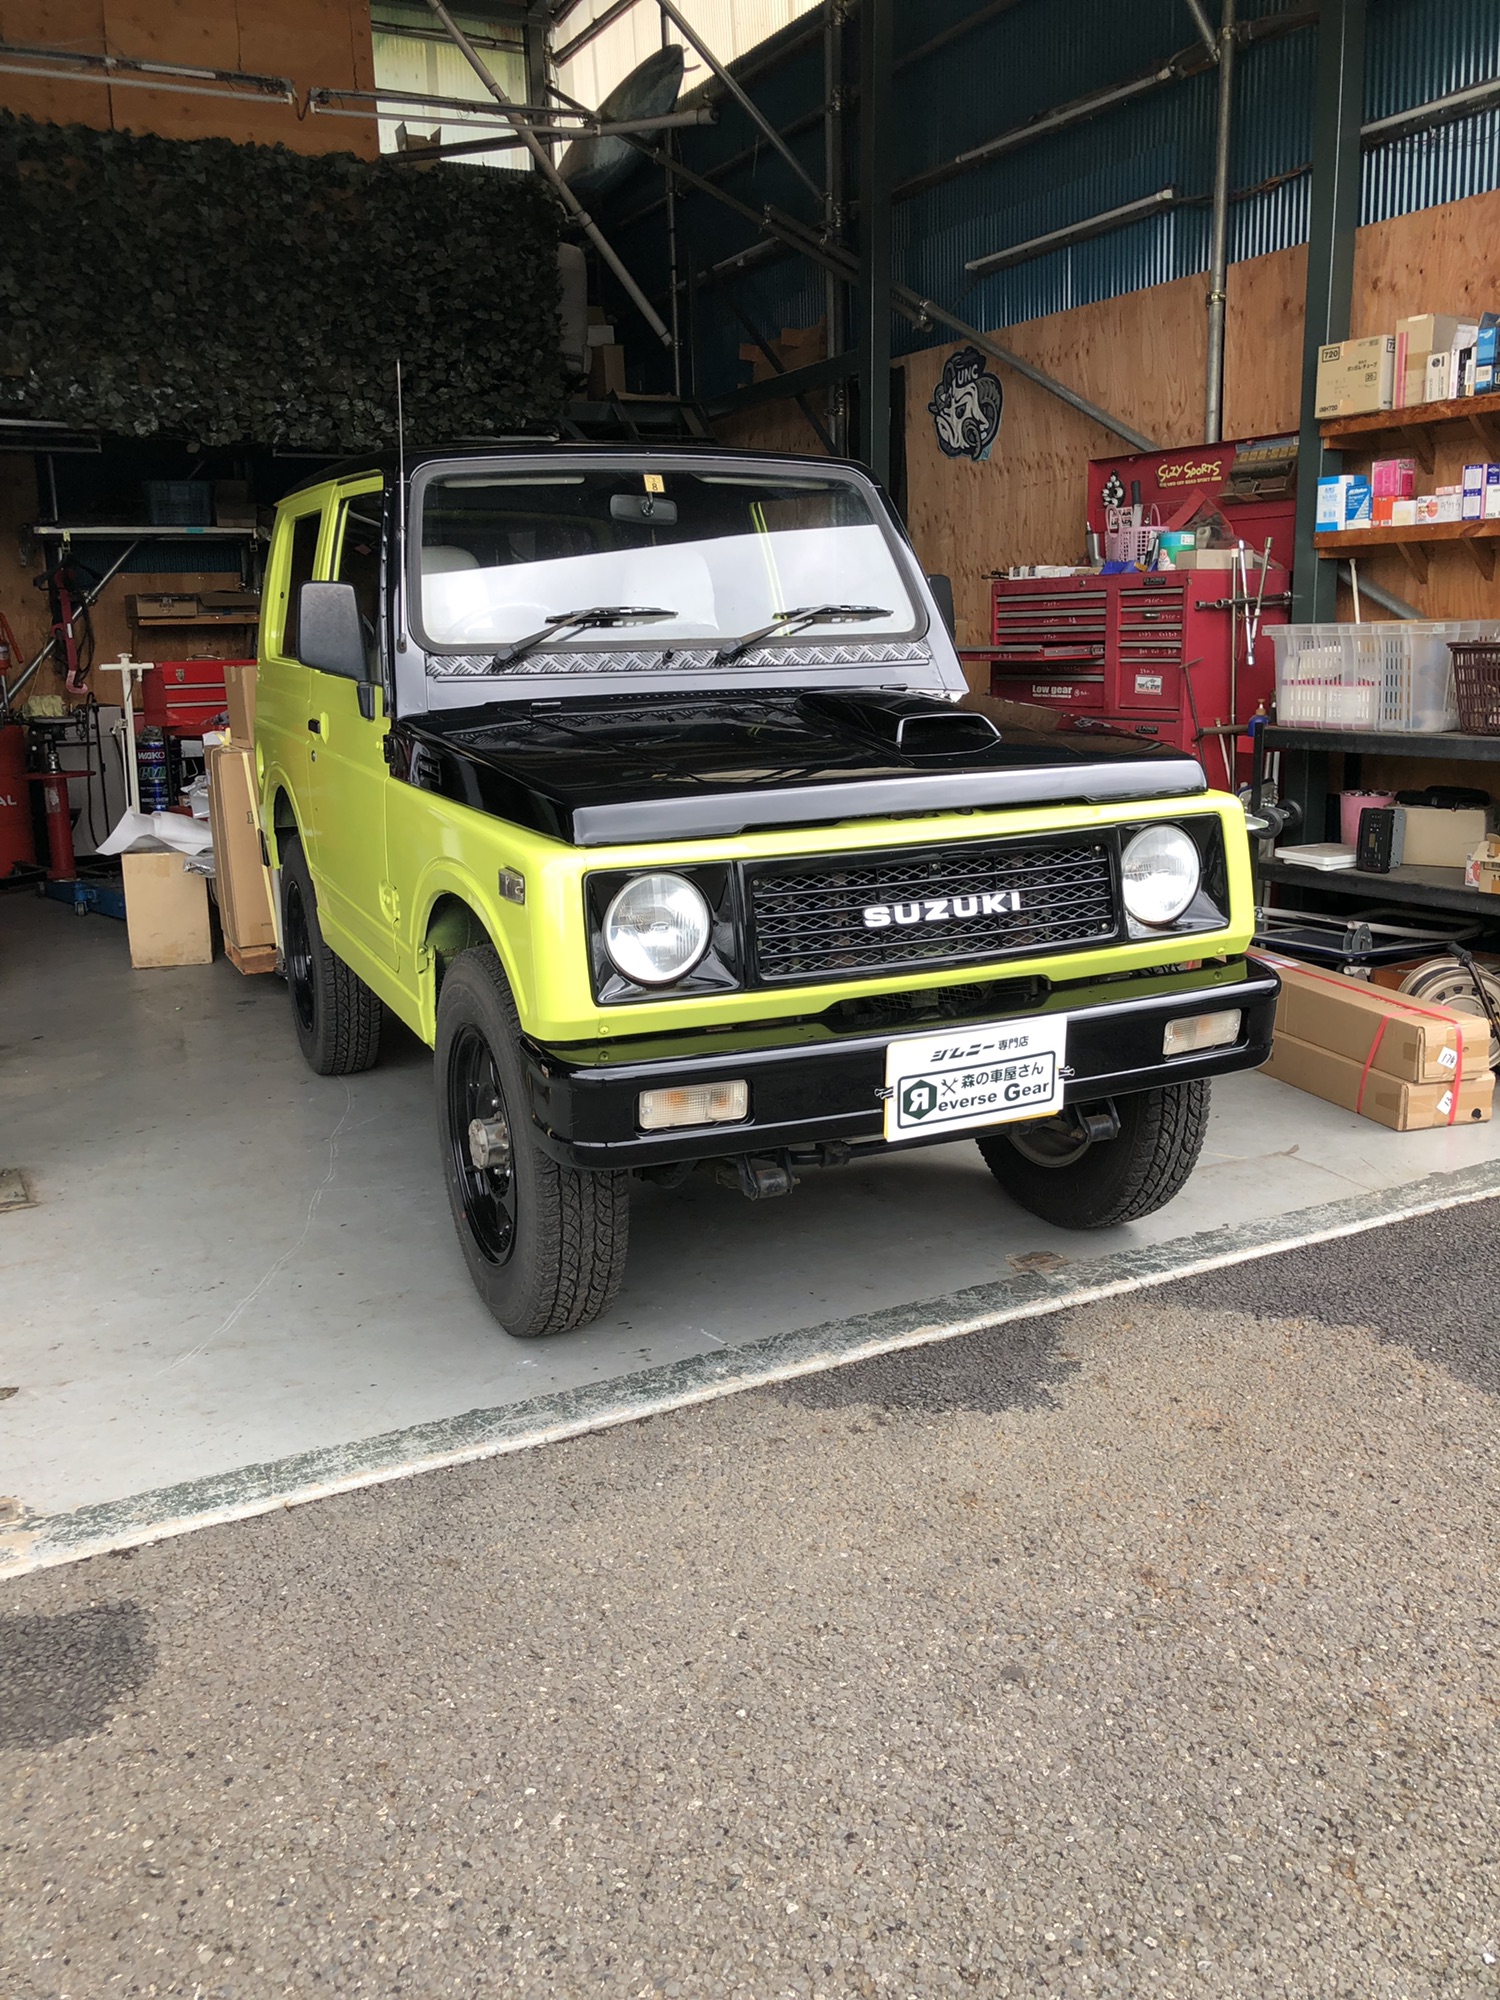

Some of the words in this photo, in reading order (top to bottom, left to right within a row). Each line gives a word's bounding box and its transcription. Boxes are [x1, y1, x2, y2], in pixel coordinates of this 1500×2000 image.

[1324, 350, 1338, 359] 720
[957, 364, 979, 384] UNC
[1158, 464, 1184, 482] SUZY
[1184, 461, 1222, 478] SPORTS
[1032, 684, 1050, 693] Low
[1051, 686, 1073, 695] gear
[863, 891, 1021, 928] SUZUKI
[961, 1062, 1044, 1089] 森の車屋さん
[1004, 1081, 1050, 1101] Gear
